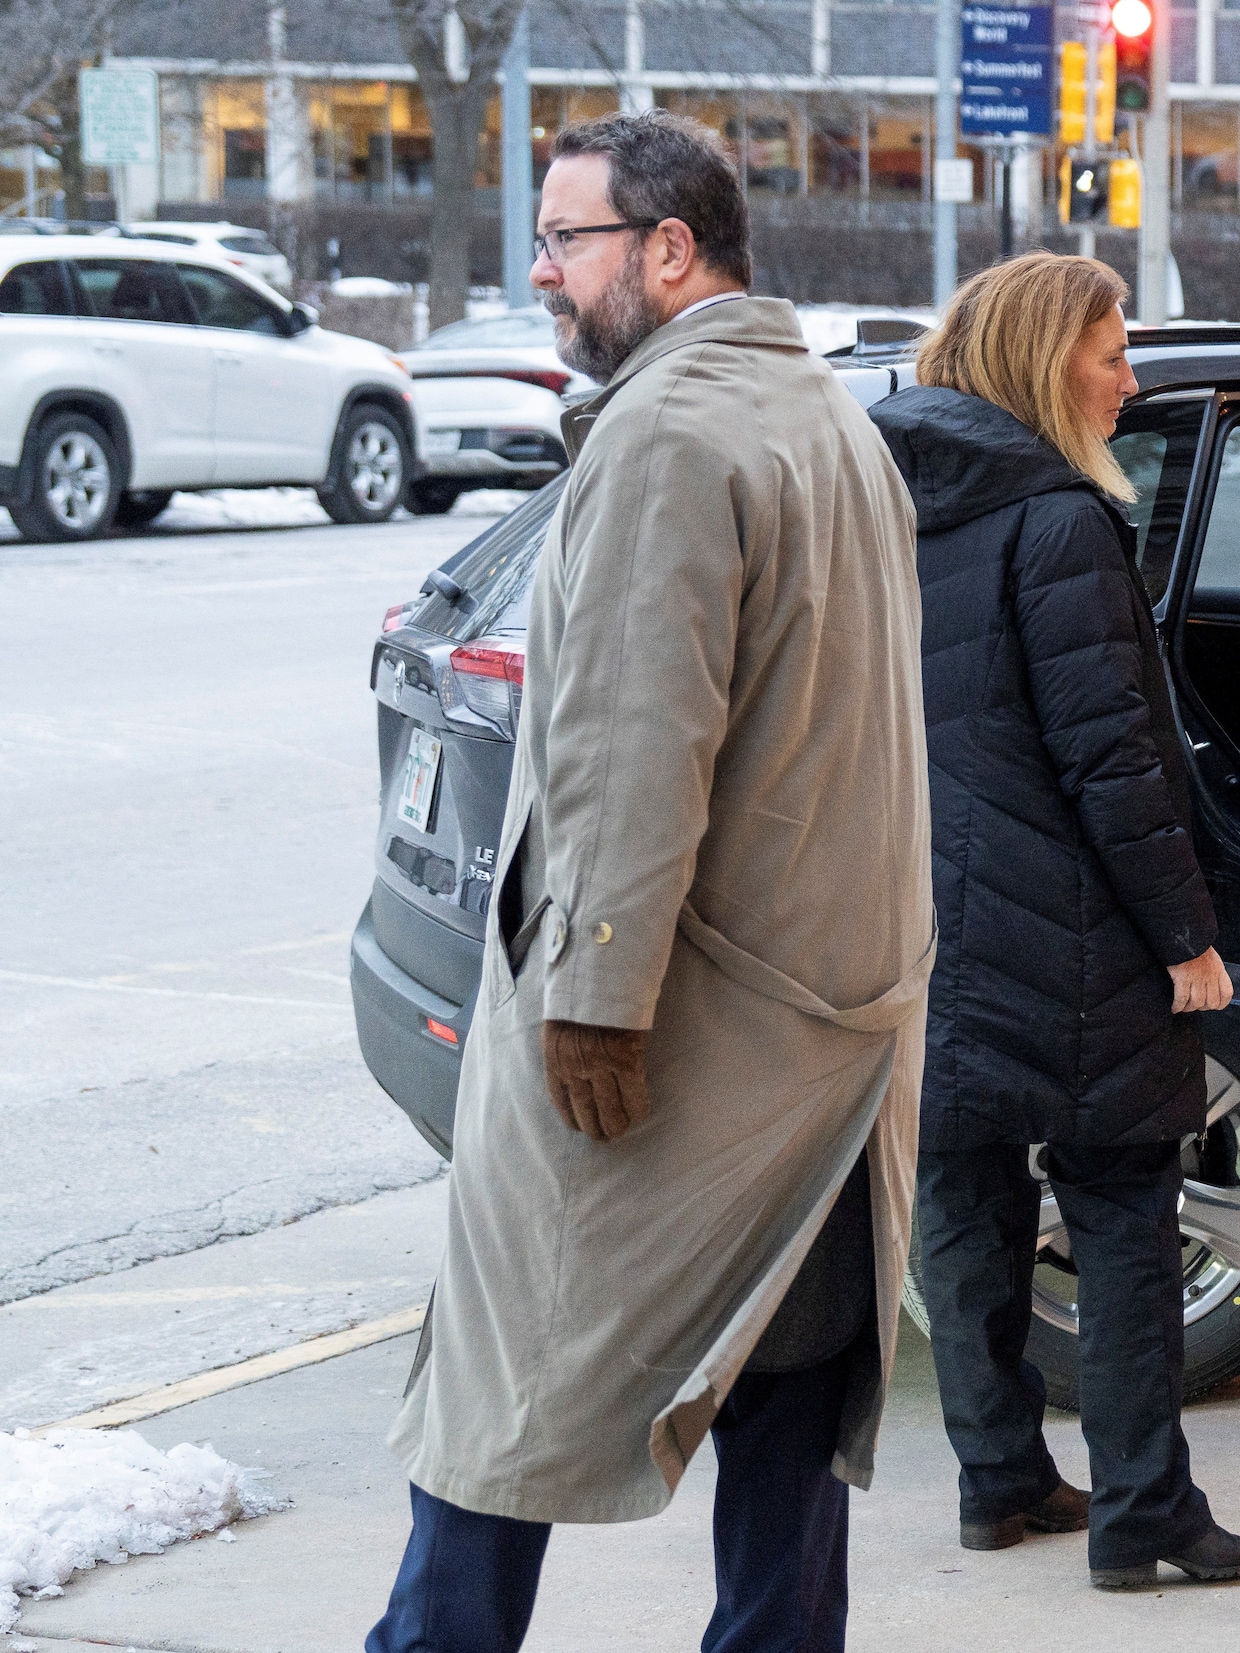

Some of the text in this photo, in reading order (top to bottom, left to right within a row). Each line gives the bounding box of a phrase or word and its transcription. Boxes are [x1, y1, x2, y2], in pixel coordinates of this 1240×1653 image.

[974, 8, 1030, 30] Discovery
[973, 25, 1008, 43] World
[973, 60, 1042, 79] Summerfest
[974, 103, 1029, 121] Lakefront
[475, 846, 495, 865] LE
